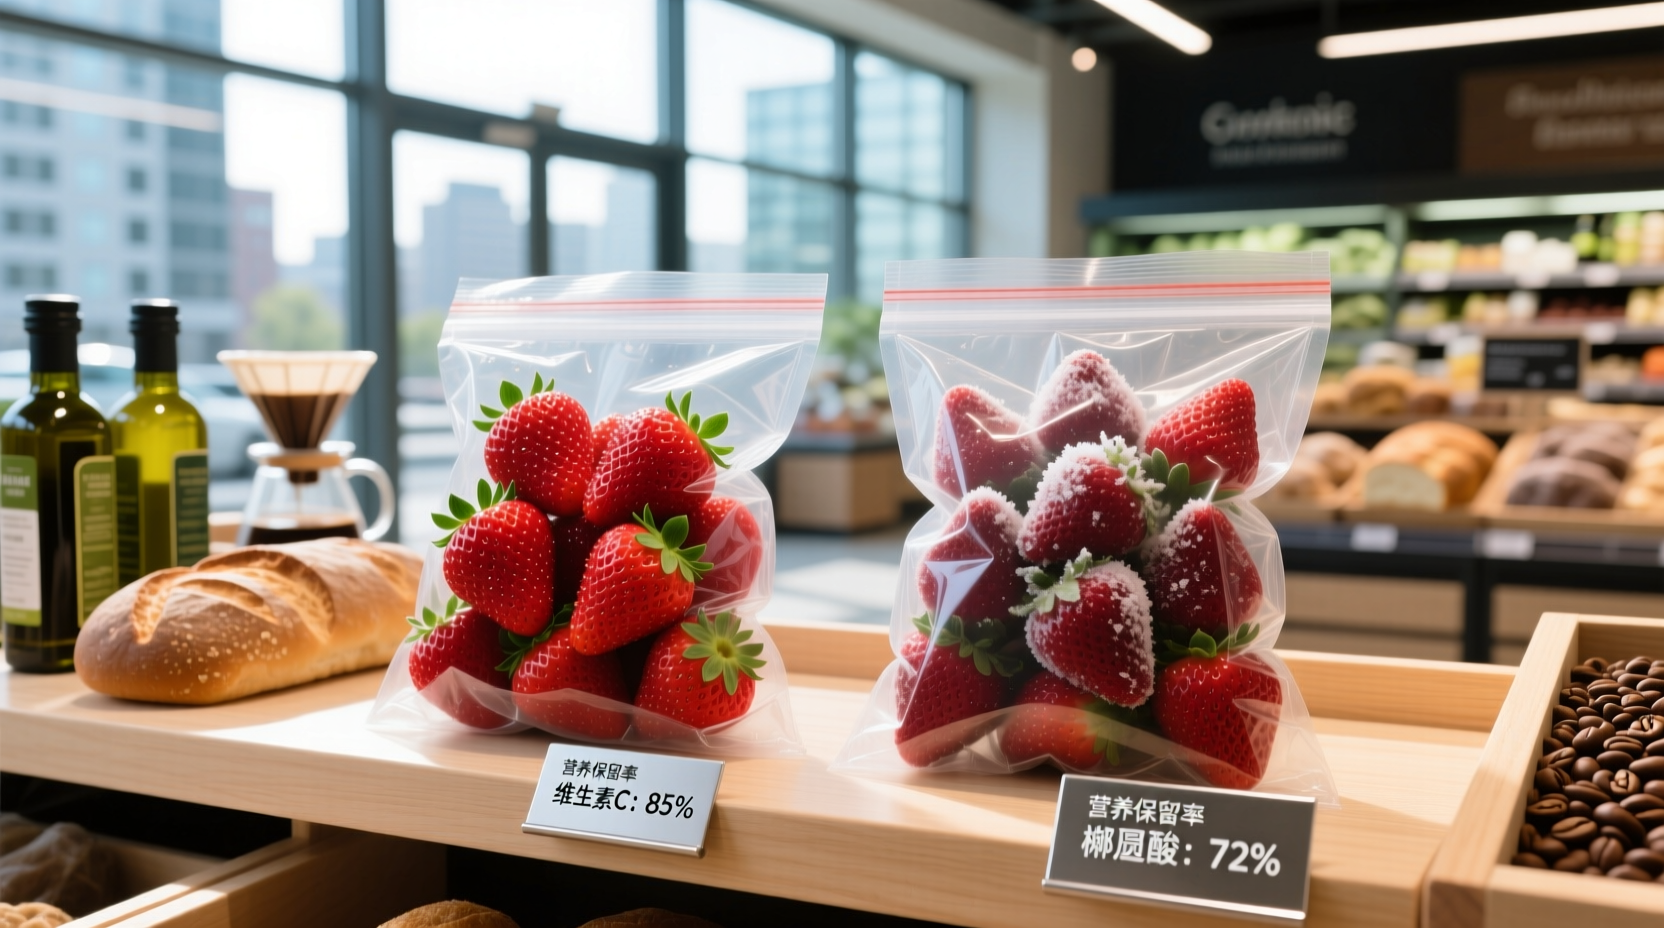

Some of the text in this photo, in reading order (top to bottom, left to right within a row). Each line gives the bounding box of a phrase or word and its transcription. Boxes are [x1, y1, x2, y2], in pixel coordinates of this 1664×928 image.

[645, 792, 694, 819] 85%
[1088, 795, 1205, 826] 营养保留率
[1209, 838, 1281, 877] 72%
